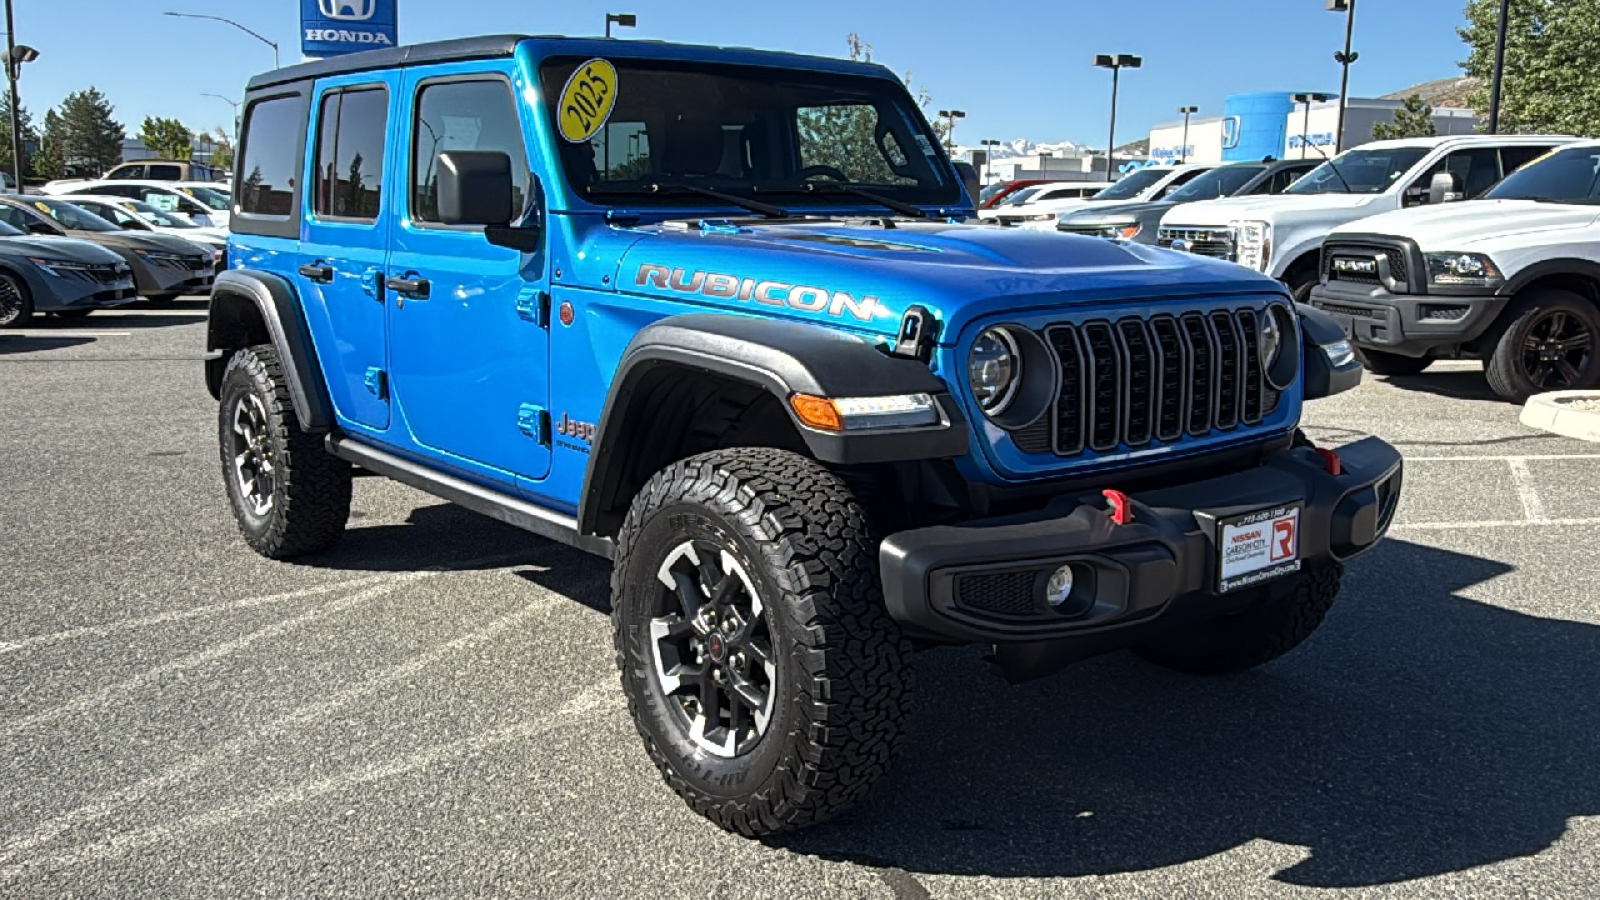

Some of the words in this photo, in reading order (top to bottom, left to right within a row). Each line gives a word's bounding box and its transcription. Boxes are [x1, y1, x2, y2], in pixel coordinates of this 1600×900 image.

[304, 29, 393, 46] HONDA
[566, 66, 609, 134] 2025
[635, 263, 879, 322] RUBICON
[555, 411, 597, 446] Jeep
[1226, 542, 1252, 556] CARSON
[1253, 539, 1266, 548] CITY
[1231, 530, 1262, 543] NISSAN
